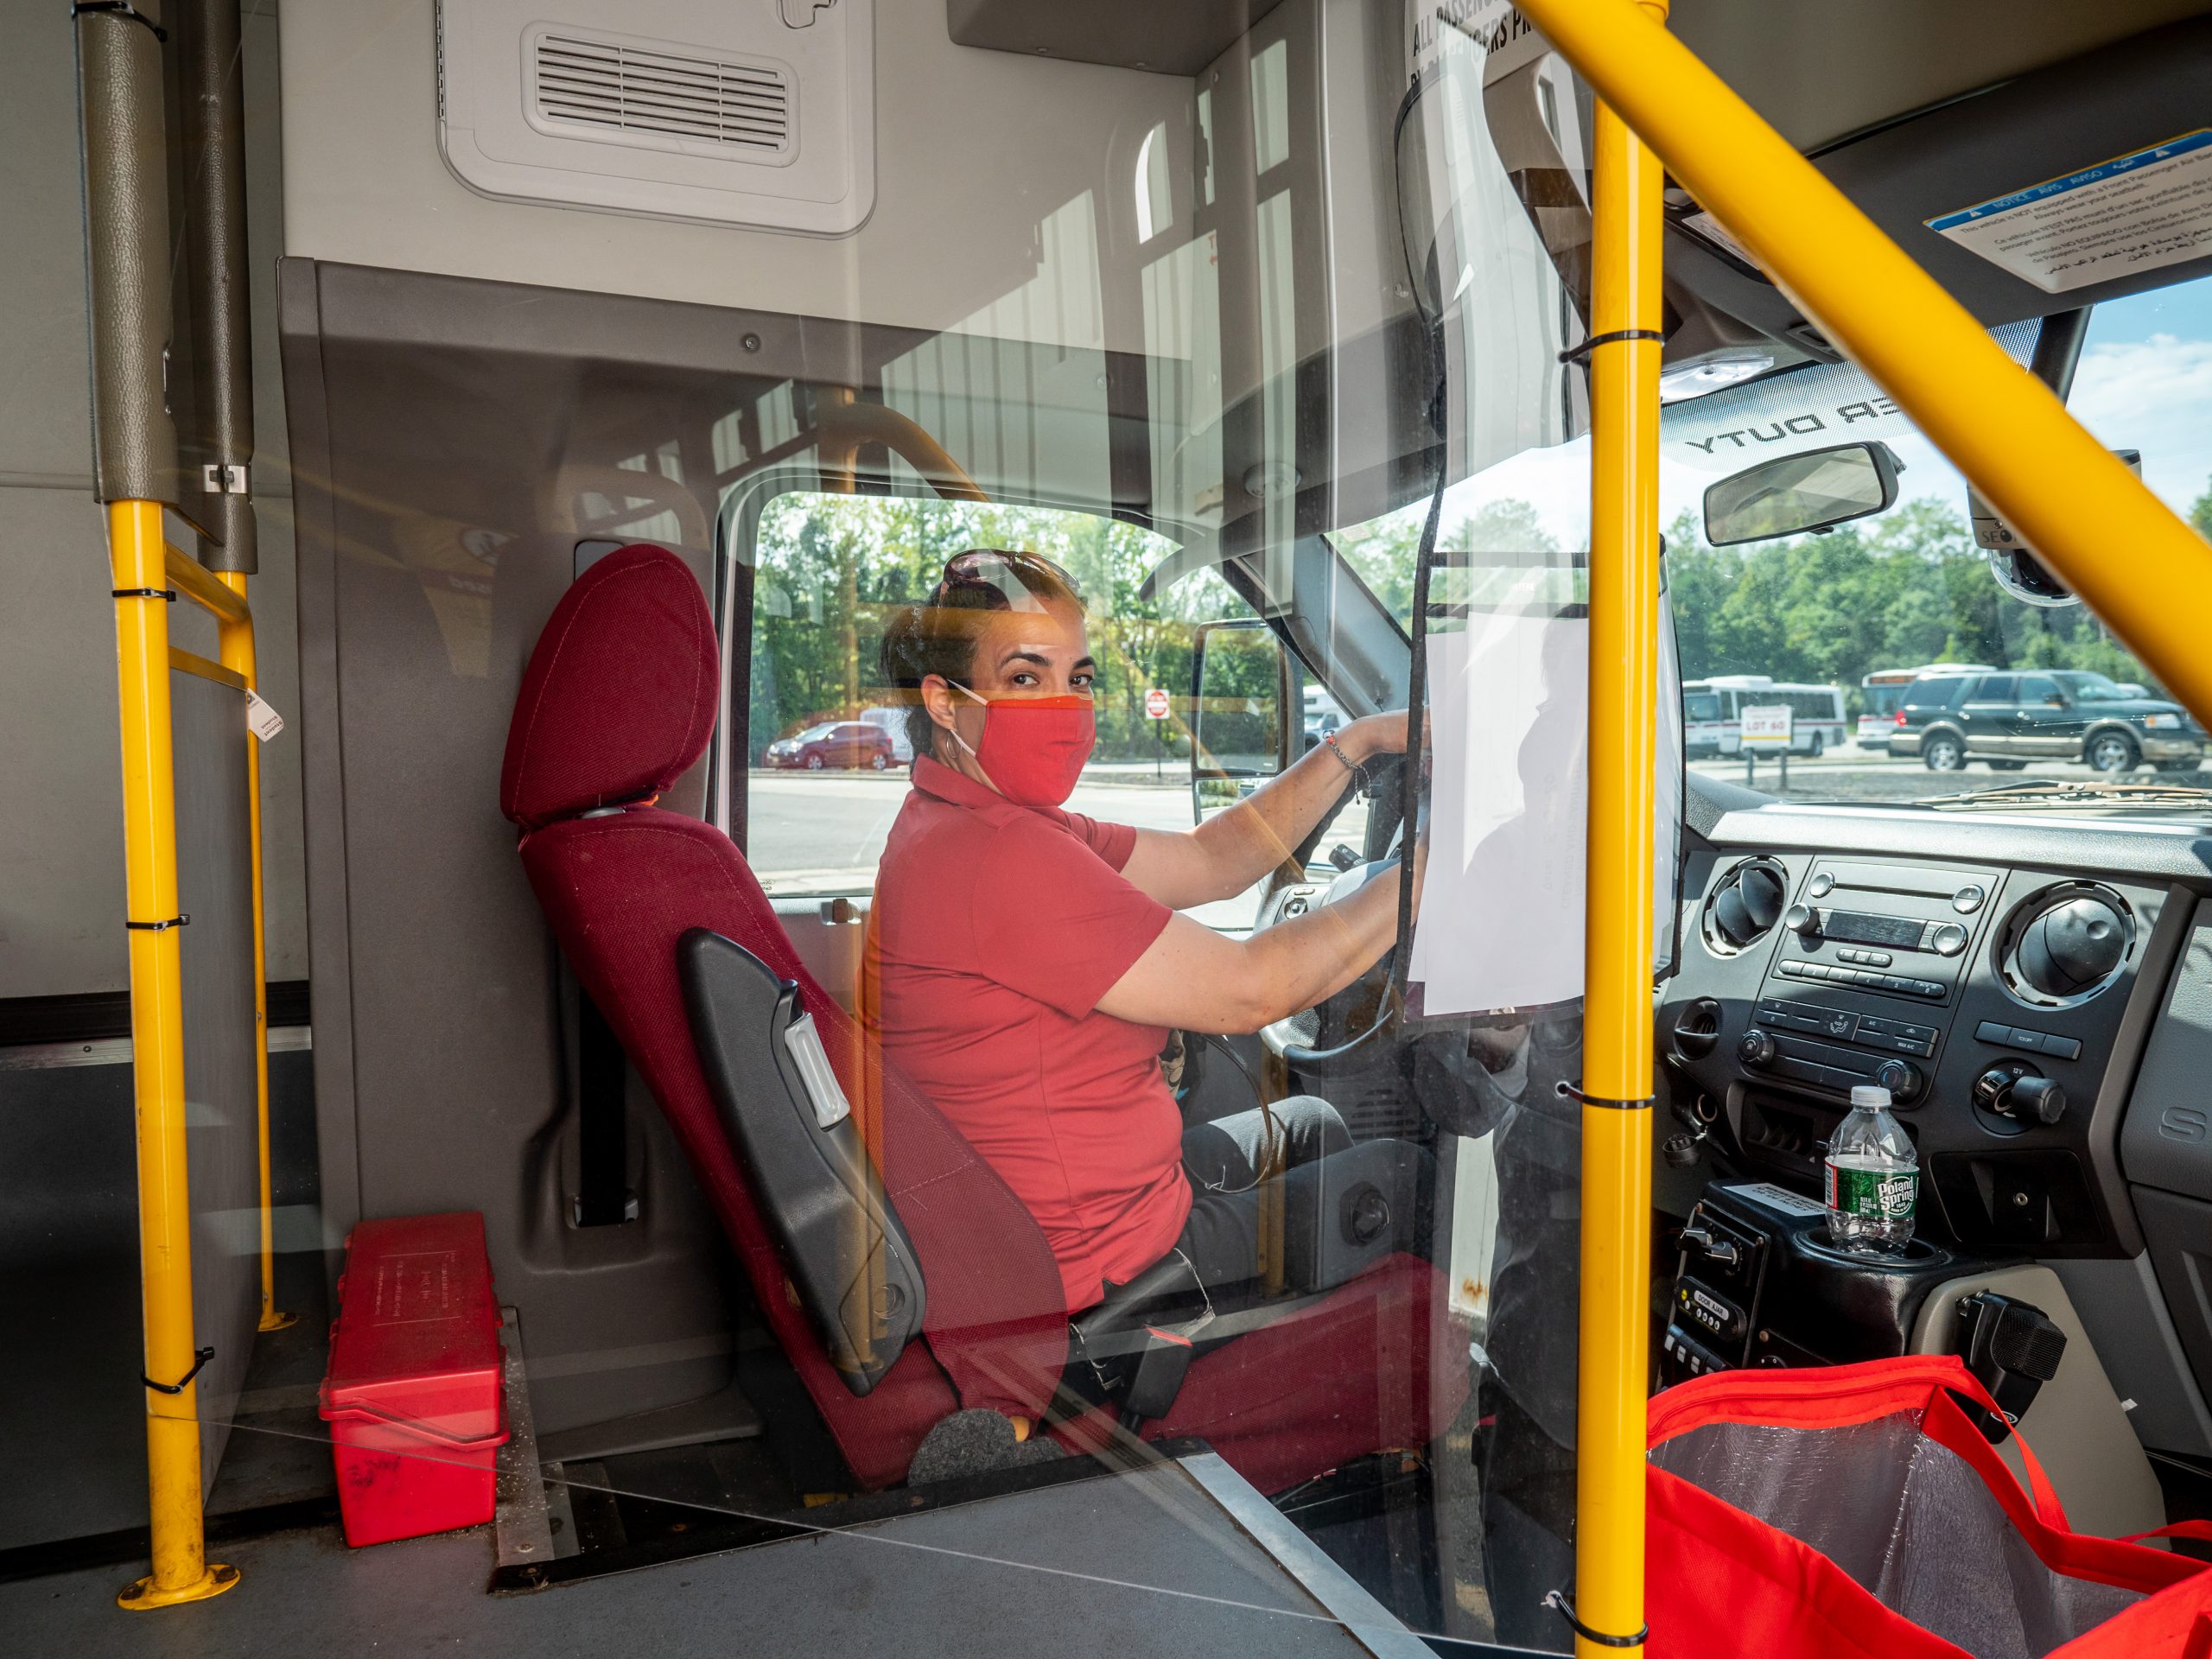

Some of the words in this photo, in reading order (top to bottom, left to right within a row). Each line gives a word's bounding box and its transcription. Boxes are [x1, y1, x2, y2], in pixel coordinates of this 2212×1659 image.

[1993, 192, 2032, 208] NOTICE
[2038, 183, 2063, 194] AVIS
[2069, 171, 2102, 185] AVISO
[2012, 209, 2032, 218] NOT
[2031, 196, 2075, 212] equipped
[1877, 1176, 1914, 1198] Poland
[1879, 1190, 1915, 1211] Spring
[1698, 1294, 1711, 1307] DOOR
[1712, 1304, 1724, 1316] AJAR
